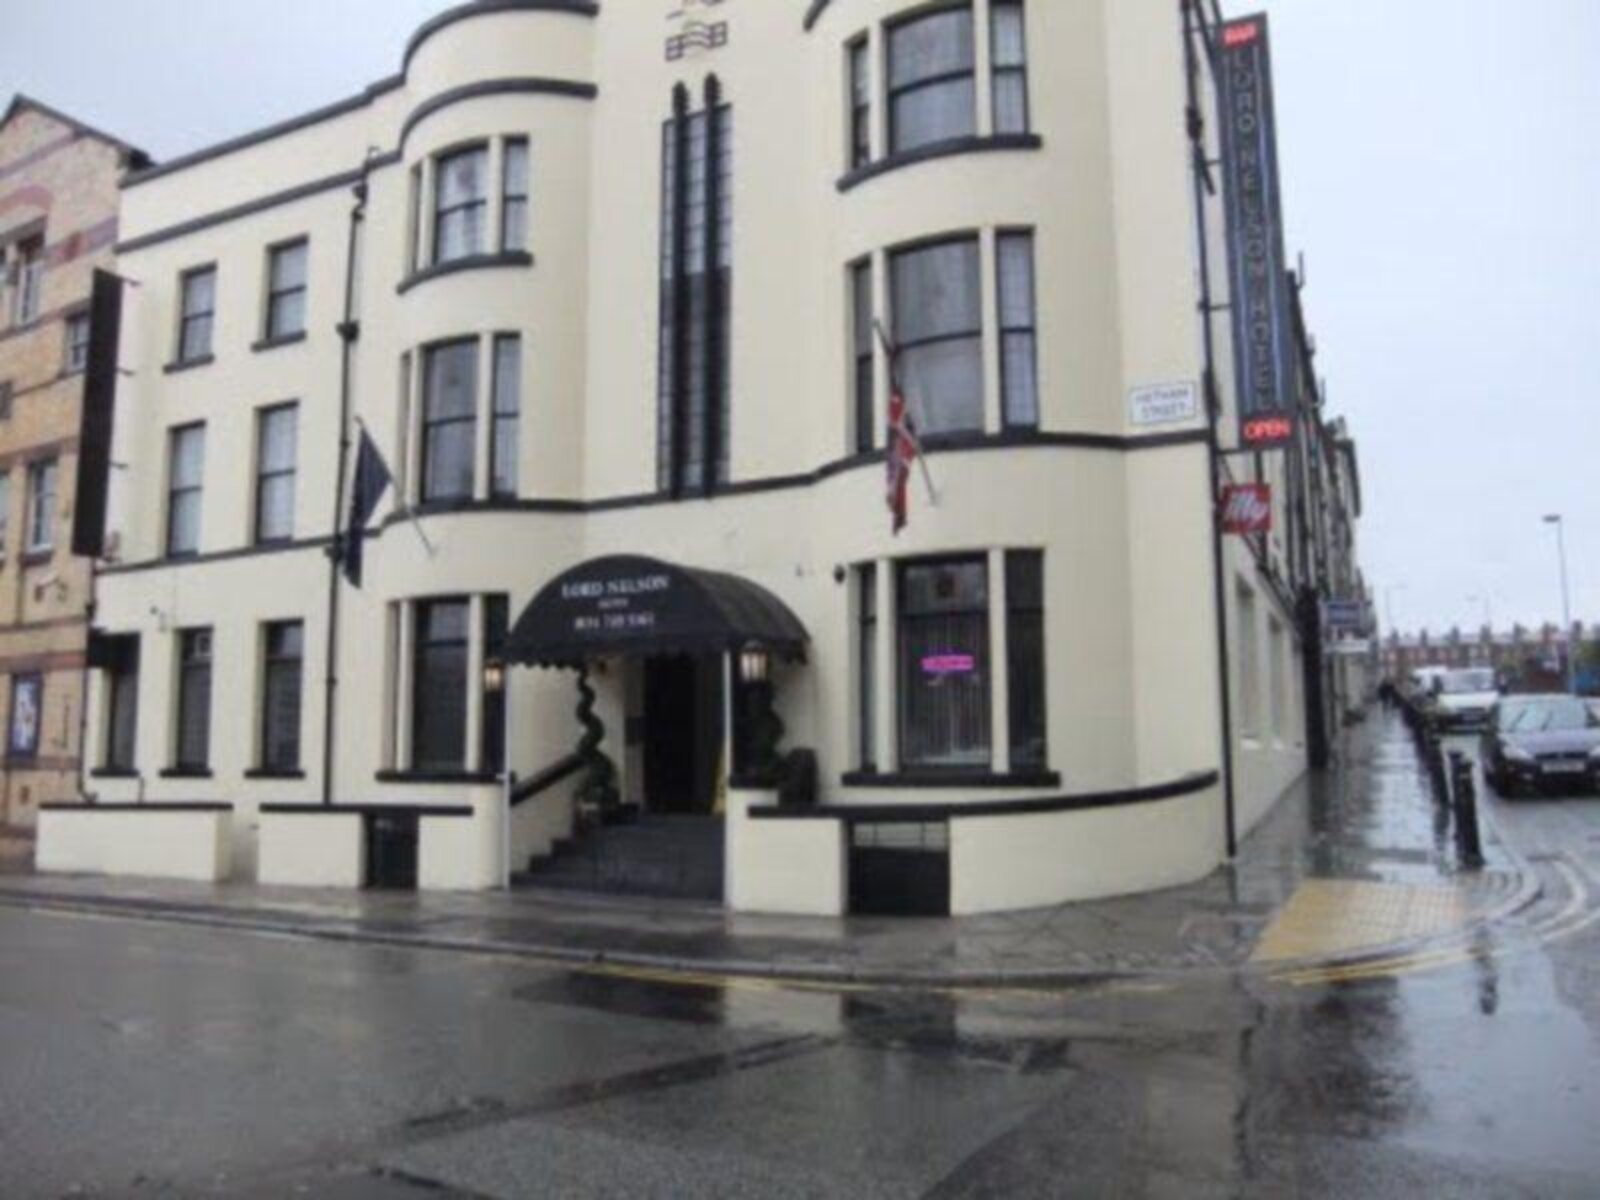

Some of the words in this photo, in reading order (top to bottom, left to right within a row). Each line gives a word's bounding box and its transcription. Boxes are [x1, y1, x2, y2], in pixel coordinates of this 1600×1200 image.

[1245, 417, 1290, 439] OPEN
[562, 582, 603, 598] LORD
[607, 576, 669, 593] NELSON
